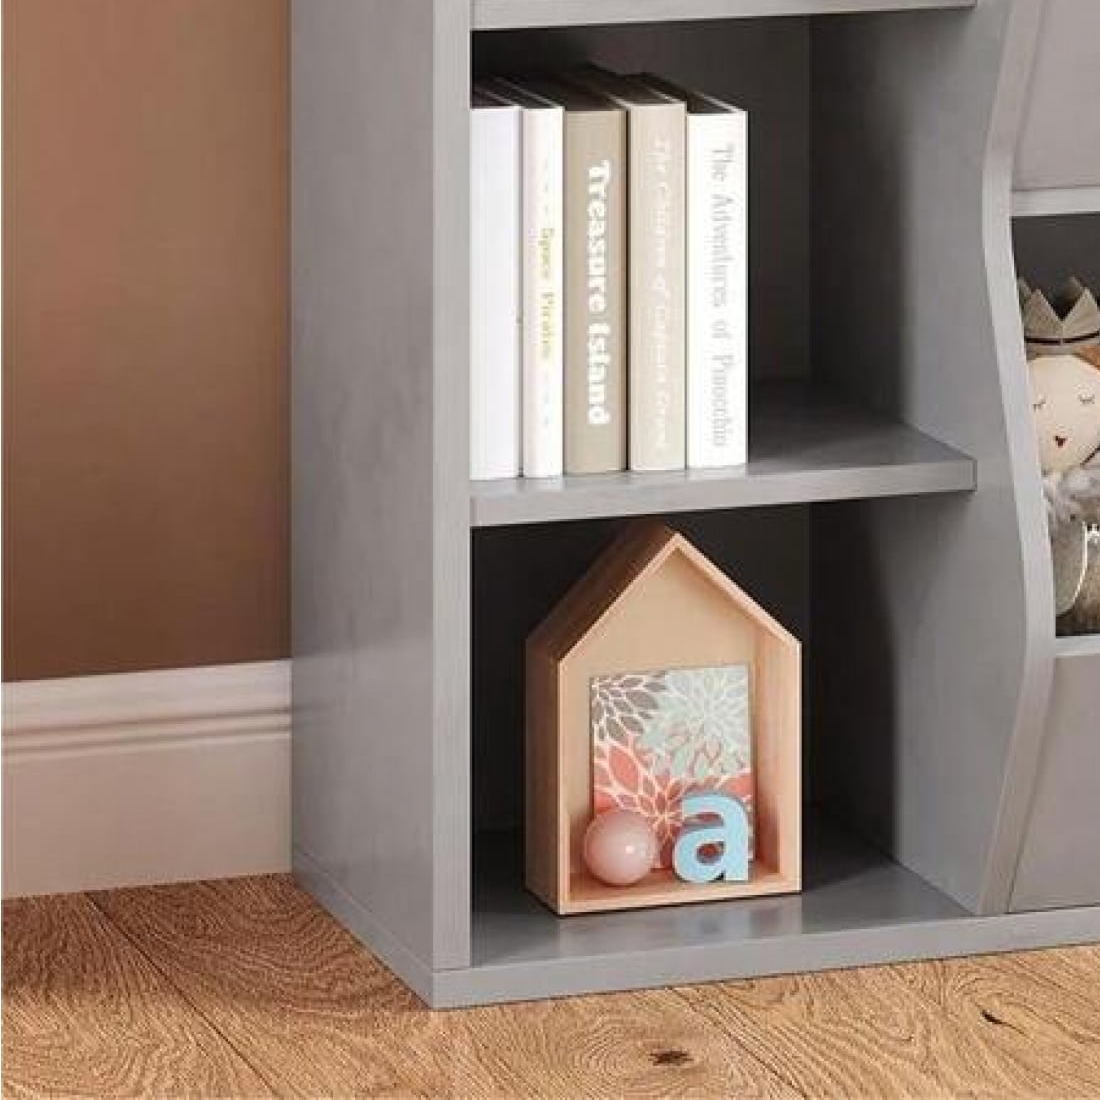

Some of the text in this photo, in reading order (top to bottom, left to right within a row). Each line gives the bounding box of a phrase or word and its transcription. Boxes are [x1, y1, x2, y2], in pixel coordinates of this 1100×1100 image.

[587, 158, 612, 313] Treasure
[711, 142, 735, 447] The Adventures of Pinocchio
[672, 792, 750, 884] a
